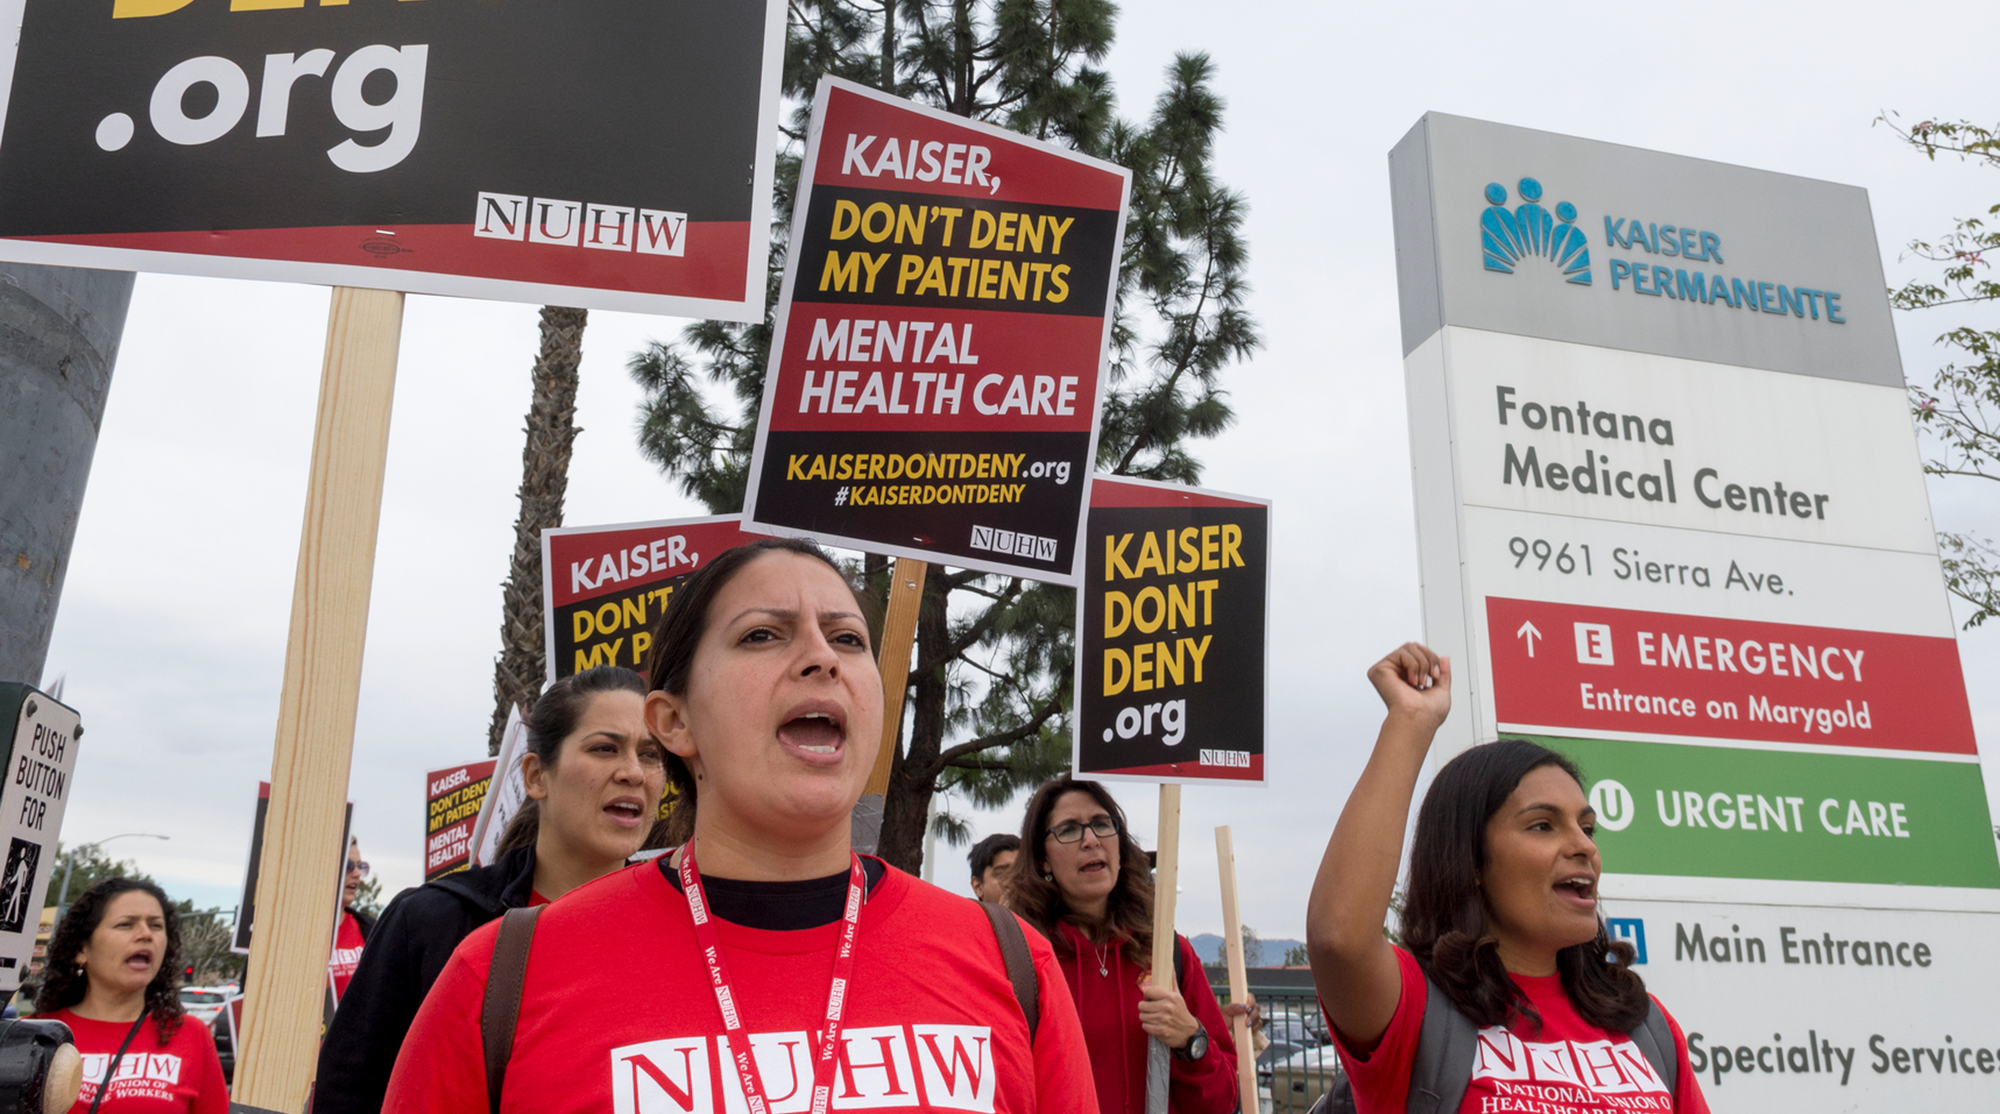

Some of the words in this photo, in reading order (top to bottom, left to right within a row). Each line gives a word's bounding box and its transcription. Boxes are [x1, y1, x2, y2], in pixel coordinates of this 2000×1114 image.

[95, 44, 430, 173] .org
[841, 133, 1001, 195] KAISER,
[476, 193, 687, 256] NUHW
[829, 199, 963, 247] DON’T
[969, 209, 1075, 255] DENY
[1604, 215, 1724, 263] KAISER
[818, 250, 891, 294] MY
[896, 255, 1071, 303] PATIENTS
[1609, 259, 1846, 324] PERMANENTE
[806, 318, 979, 365] MENTAL
[798, 371, 965, 414] HEALTH
[973, 375, 1079, 416] CARE
[1496, 385, 1674, 446] Fontana
[786, 453, 1071, 485] KAISERDONTDENY.org
[1503, 443, 1677, 503] Medical
[1693, 468, 1830, 520] Center
[834, 484, 1026, 507] #KAISERDONTDENY
[571, 534, 699, 594] KAISER,
[971, 526, 1057, 561] NUHW
[1105, 524, 1246, 581] KAISER
[1508, 536, 1593, 577] 9961
[1613, 546, 1711, 588] Sierra
[1725, 560, 1794, 597] Ave.
[1104, 579, 1219, 639] DONT
[574, 637, 624, 675] MY
[1103, 635, 1213, 697] DENY
[1587, 629, 1603, 660] E
[1637, 631, 1864, 682] EMERGENCY
[1103, 699, 1186, 747] .org
[1580, 683, 1697, 718] Entrance
[1706, 699, 1738, 720] on
[1749, 695, 1872, 734] Marygold
[31, 723, 67, 763] PUSH
[1200, 749, 1250, 767] NUHW
[16, 755, 66, 801] BUTTON
[431, 768, 470, 796] KAISER,
[20, 796, 46, 831] FOR
[429, 813, 446, 832] MY
[446, 796, 485, 825] PATIENT
[1599, 788, 1622, 821] U
[1656, 790, 1804, 833] URGENT
[1819, 798, 1910, 838] CARE
[429, 824, 468, 854] MENTAL
[429, 839, 465, 869] HEALTH
[682, 869, 693, 885] Are
[683, 854, 691, 869] We
[686, 883, 708, 925] NUHW
[845, 883, 861, 923] NUHW
[840, 941, 850, 958] We
[843, 923, 855, 941] Are
[1675, 922, 1767, 964] Main
[1780, 926, 1933, 968] Entrance
[705, 946, 717, 965] We
[710, 964, 722, 984] Are
[715, 985, 740, 1030] NUHW
[827, 977, 846, 1021] NUHW
[822, 1042, 834, 1061] We
[825, 1022, 838, 1042] Are
[80, 1054, 181, 1083] UHW
[737, 1051, 749, 1071] We
[1687, 1029, 1855, 1086] Specialty
[1869, 1034, 2000, 1074] Service
[109, 1080, 151, 1092] UNION
[152, 1081, 168, 1090] OF
[116, 1088, 174, 1102] WORKERS
[742, 1071, 755, 1093] Are
[1493, 1080, 1601, 1104] NATIONAL
[1602, 1094, 1659, 1110] UNION
[1660, 1096, 1671, 1110] O
